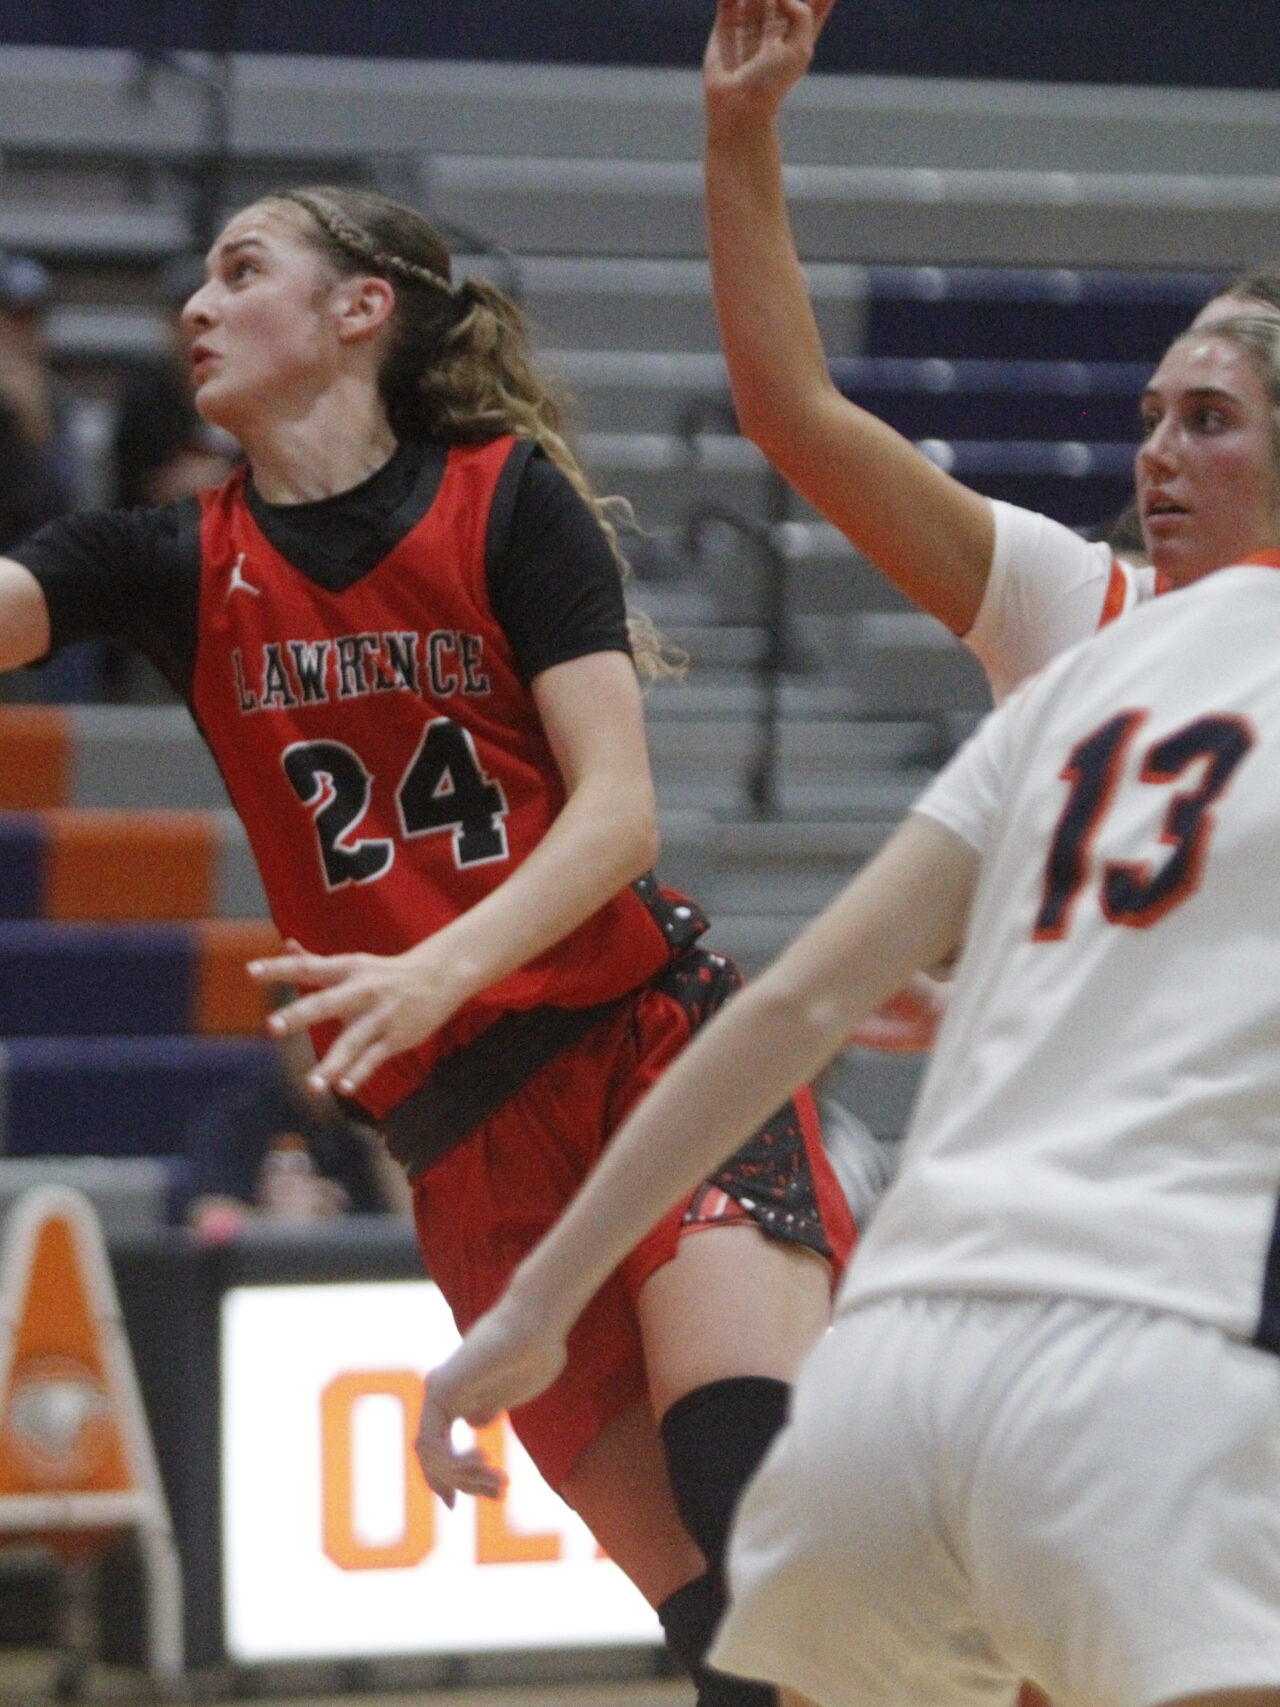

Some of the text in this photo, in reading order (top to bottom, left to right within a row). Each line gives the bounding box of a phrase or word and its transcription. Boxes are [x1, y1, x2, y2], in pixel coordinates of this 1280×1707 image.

[231, 629, 492, 716] LAWRENCE
[281, 716, 510, 892] 24
[1029, 706, 1260, 944] 13
[320, 1366, 612, 1572] OL
